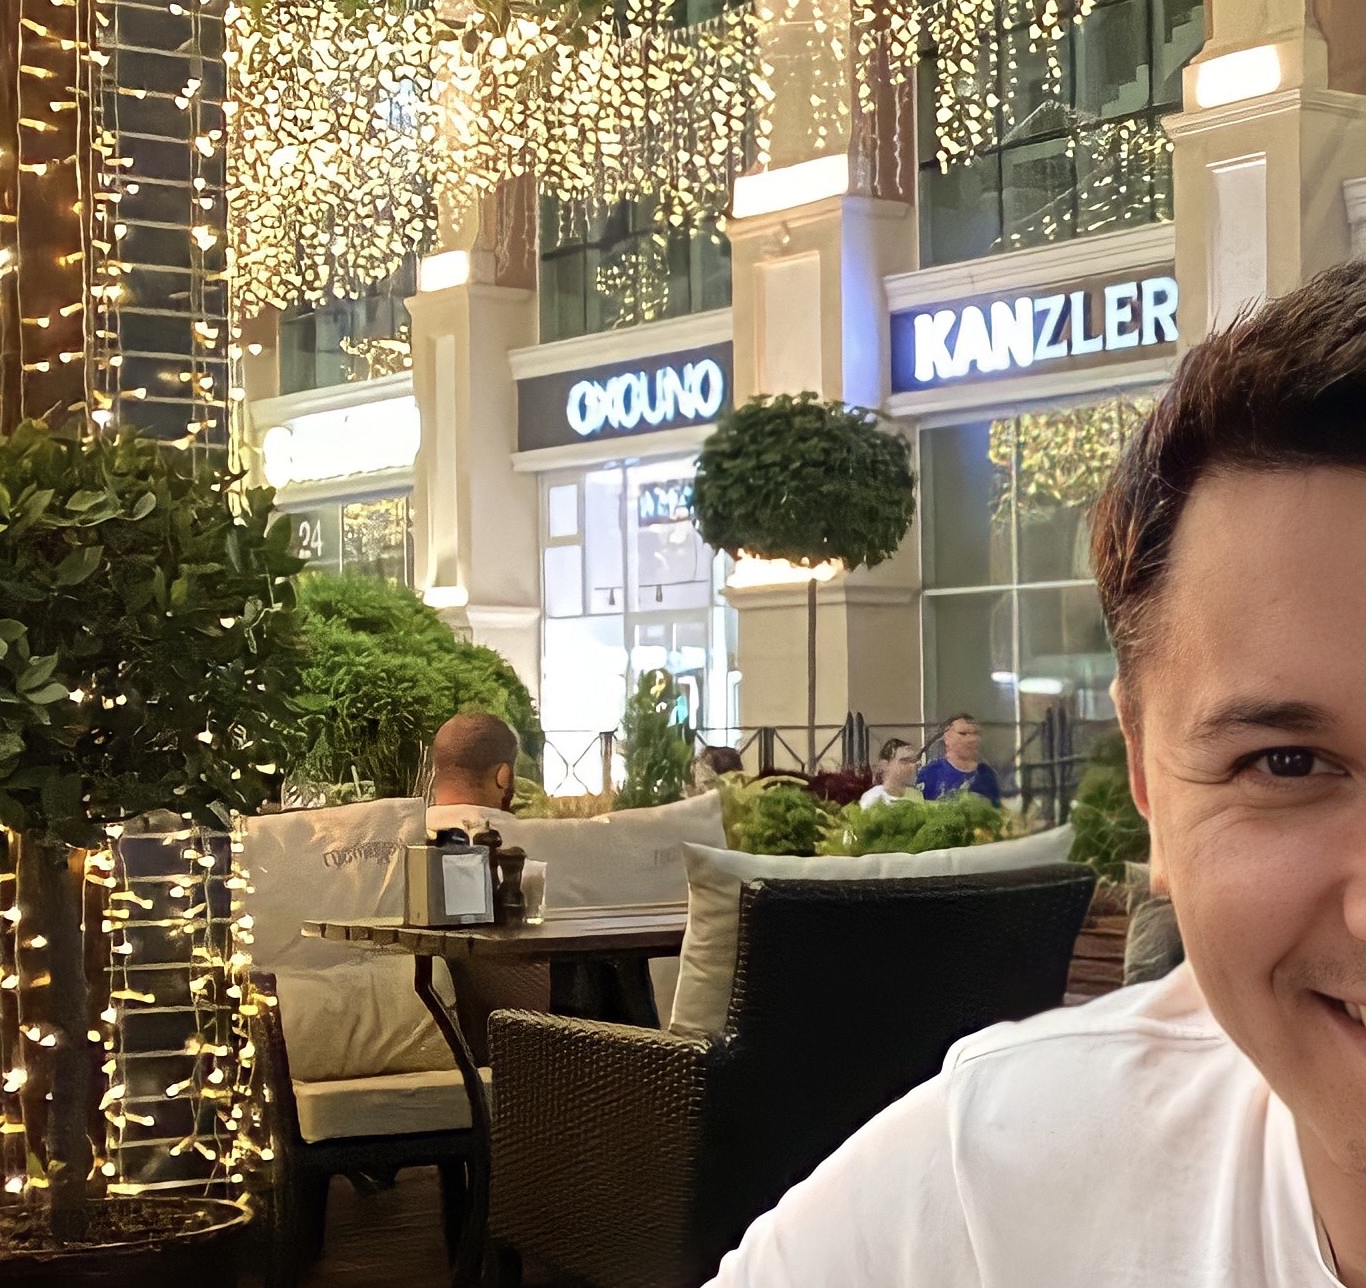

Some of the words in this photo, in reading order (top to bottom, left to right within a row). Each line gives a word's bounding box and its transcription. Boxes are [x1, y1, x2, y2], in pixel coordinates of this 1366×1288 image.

[914, 277, 1179, 382] KANZLER
[566, 359, 723, 435] OXOUNO
[299, 520, 322, 559] 24
